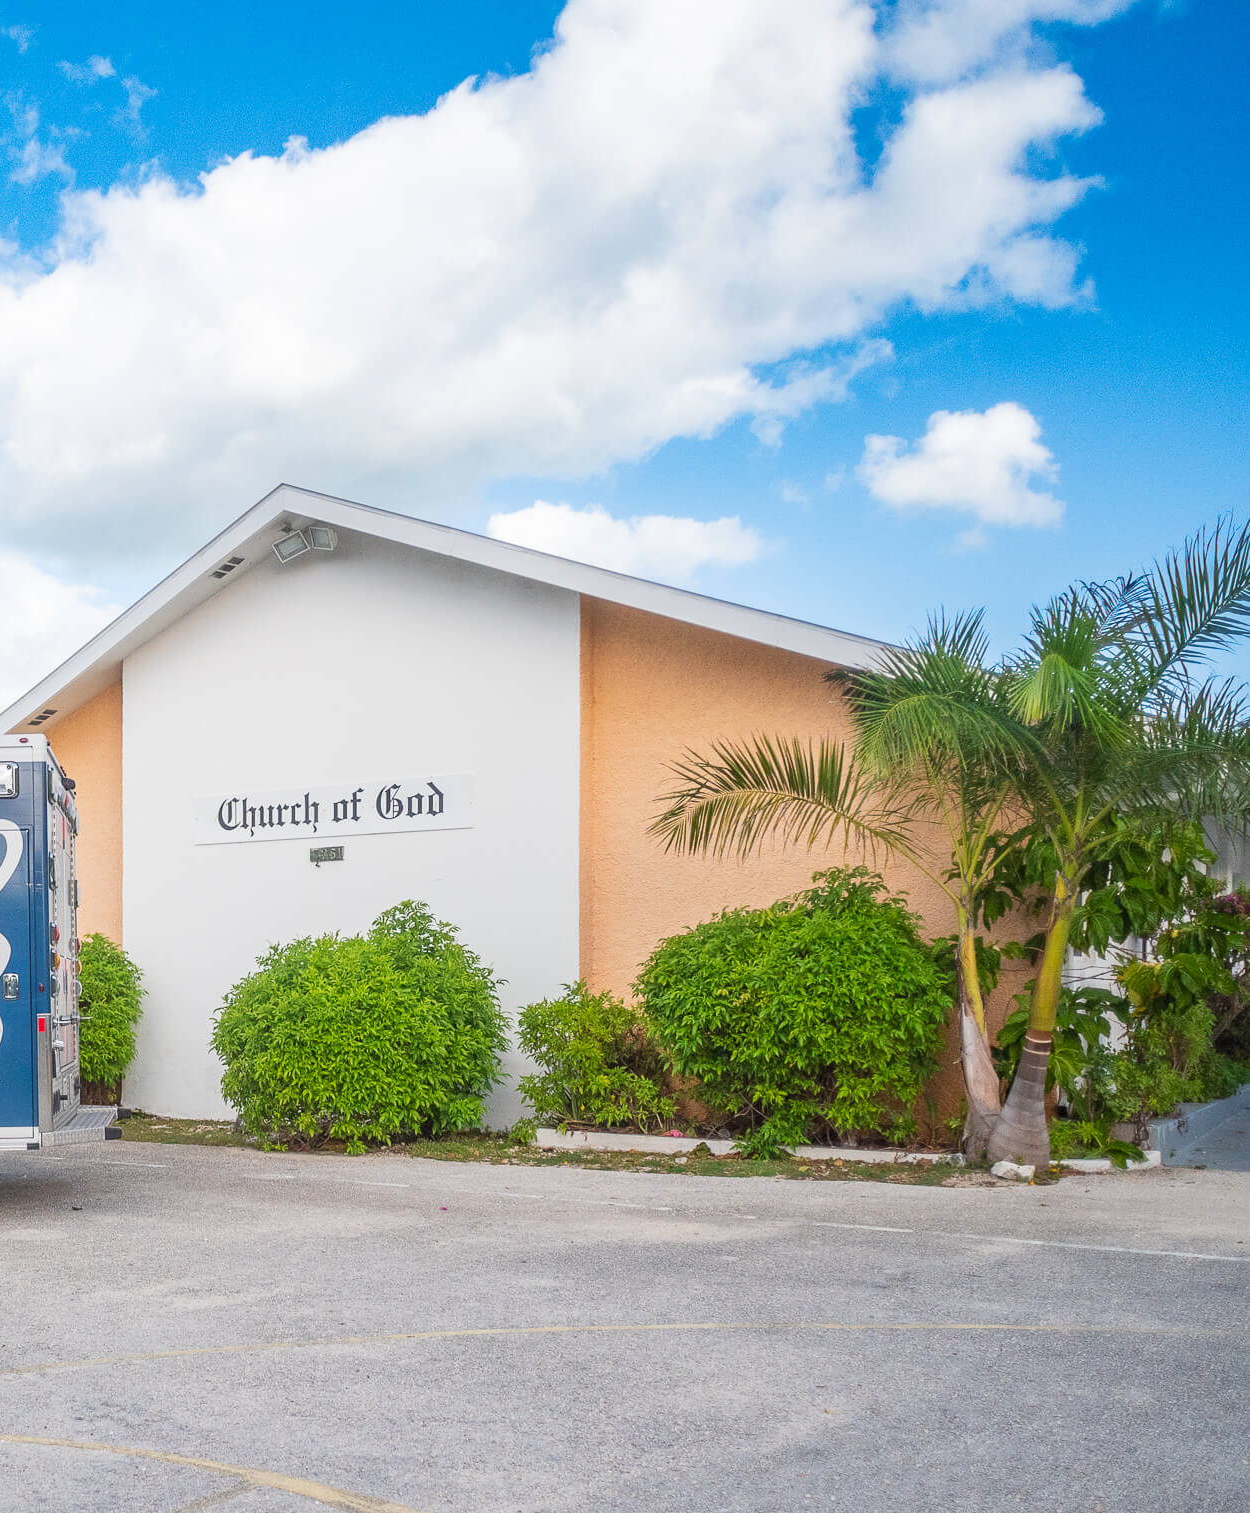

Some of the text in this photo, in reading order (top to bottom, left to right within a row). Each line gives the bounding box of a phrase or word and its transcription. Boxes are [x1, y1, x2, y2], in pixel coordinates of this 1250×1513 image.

[217, 782, 444, 837] Church of God
